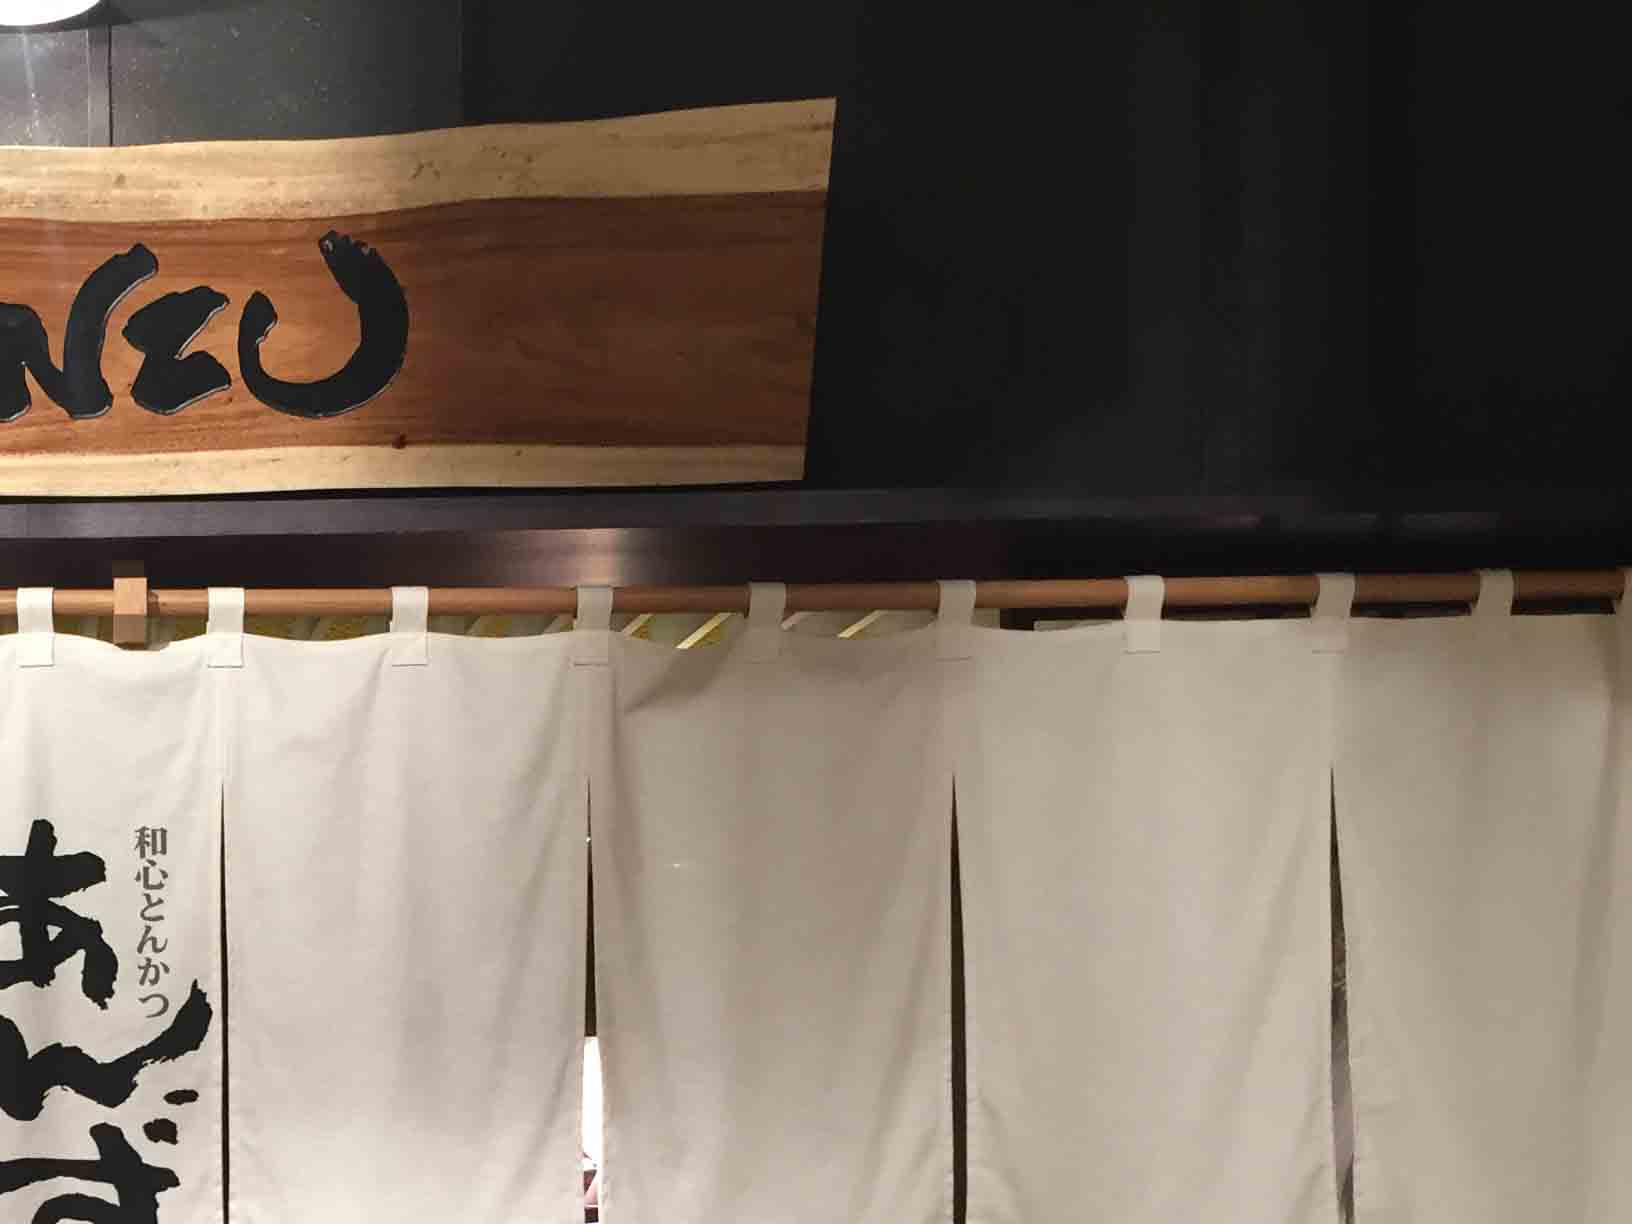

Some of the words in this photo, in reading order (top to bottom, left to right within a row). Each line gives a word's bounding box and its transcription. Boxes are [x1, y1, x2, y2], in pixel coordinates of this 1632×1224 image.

[134, 825, 170, 1019] 和心とんかつ
